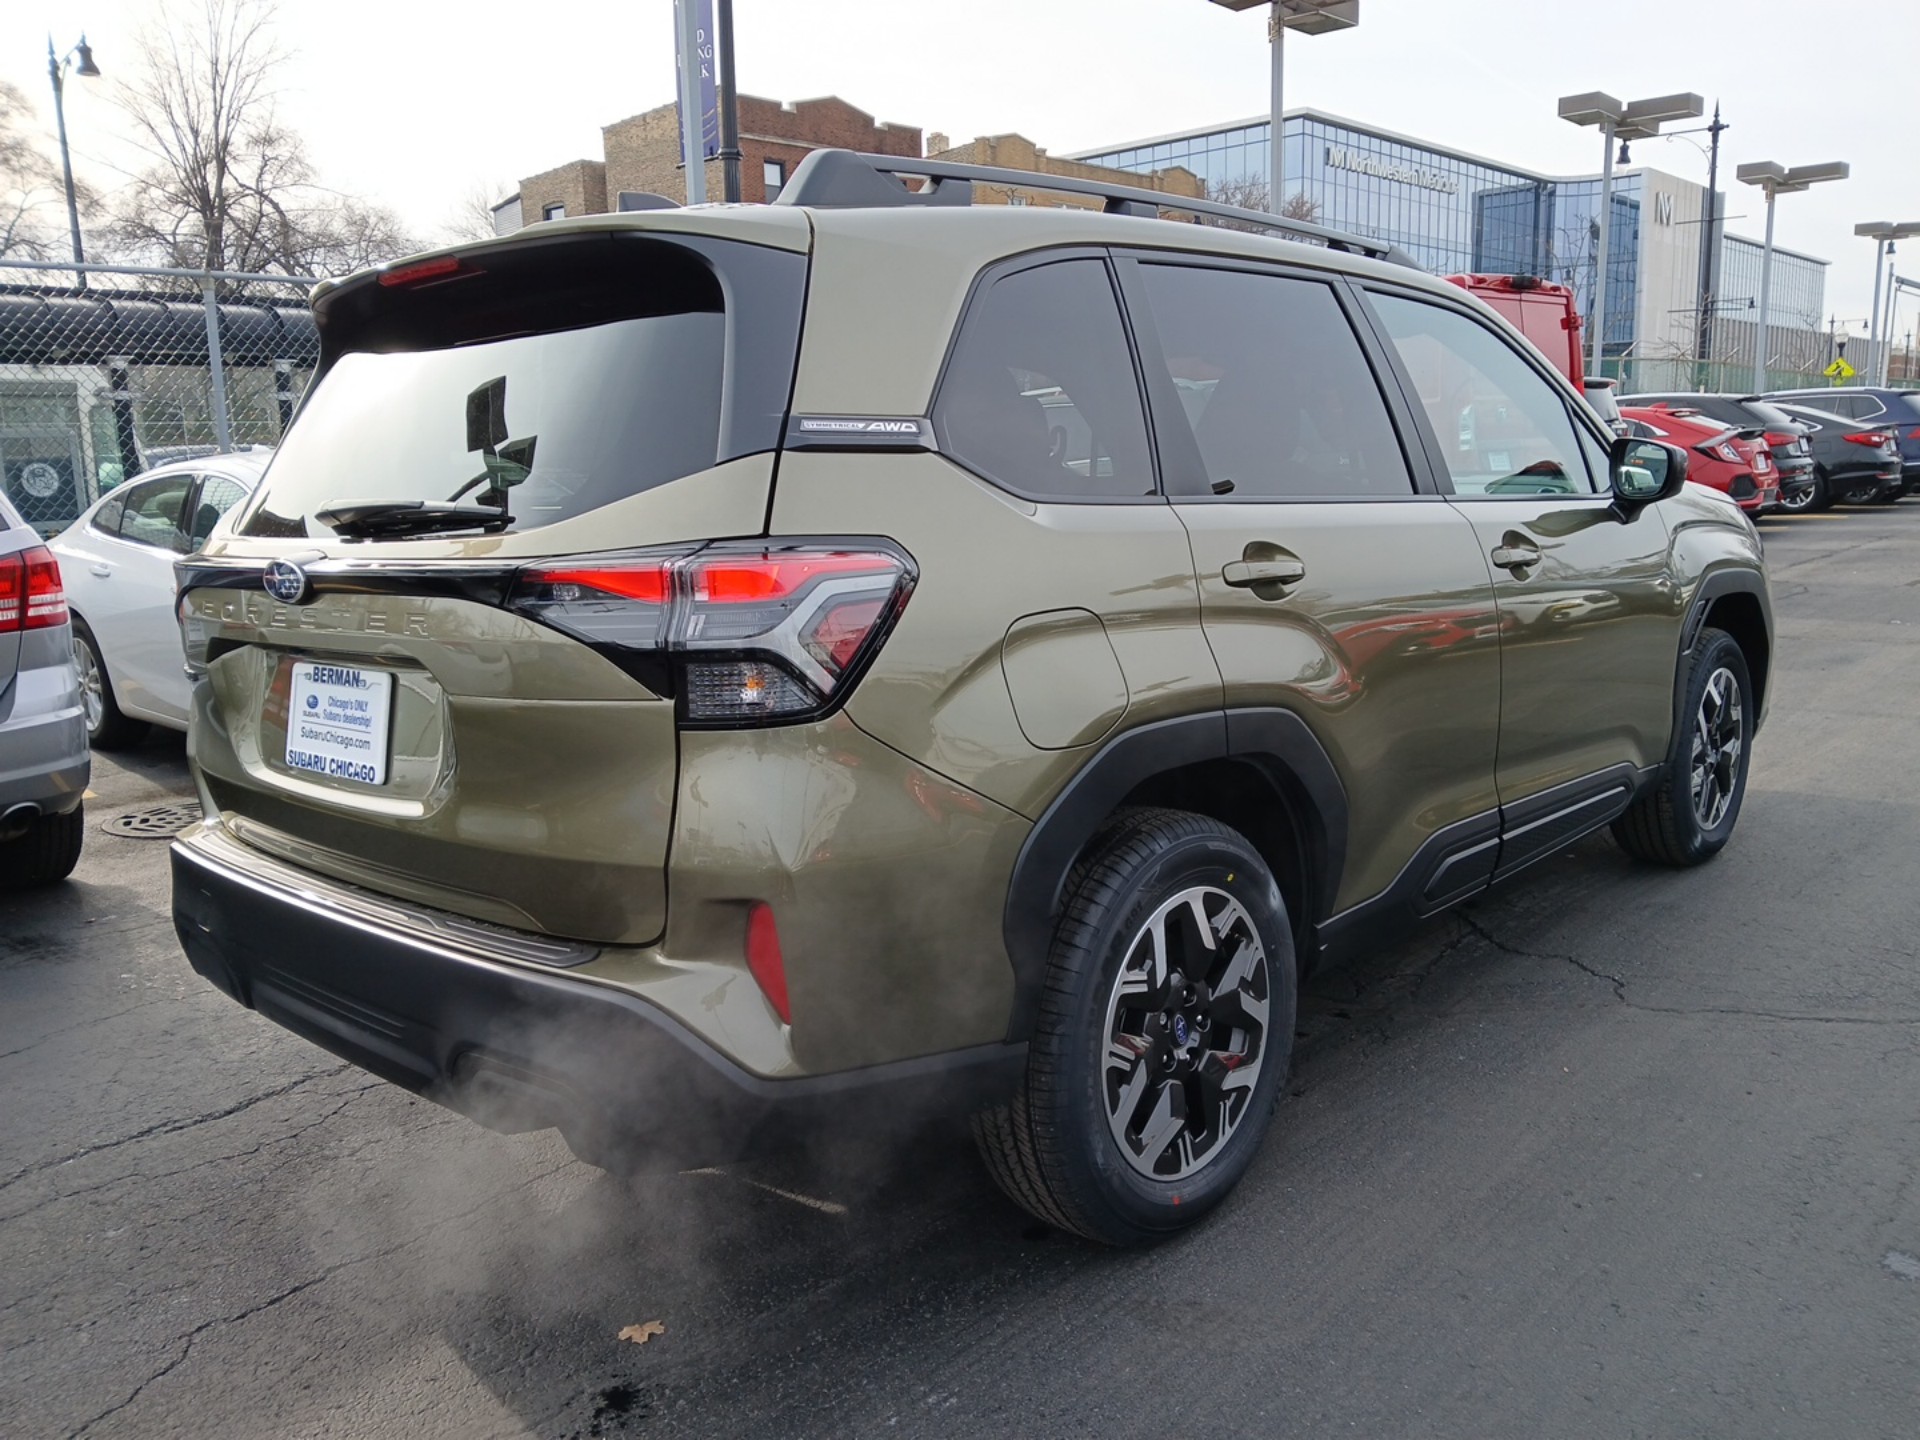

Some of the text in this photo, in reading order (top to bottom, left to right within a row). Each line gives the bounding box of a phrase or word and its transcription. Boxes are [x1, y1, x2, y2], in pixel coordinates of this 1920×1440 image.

[1347, 150, 1419, 187] Northwestern
[803, 421, 918, 432] SYMMETRICAL AWD
[313, 666, 360, 688] BERMAN
[300, 726, 371, 750] SubaruChicago.com
[288, 749, 376, 783] SUBARU CHICAGO
